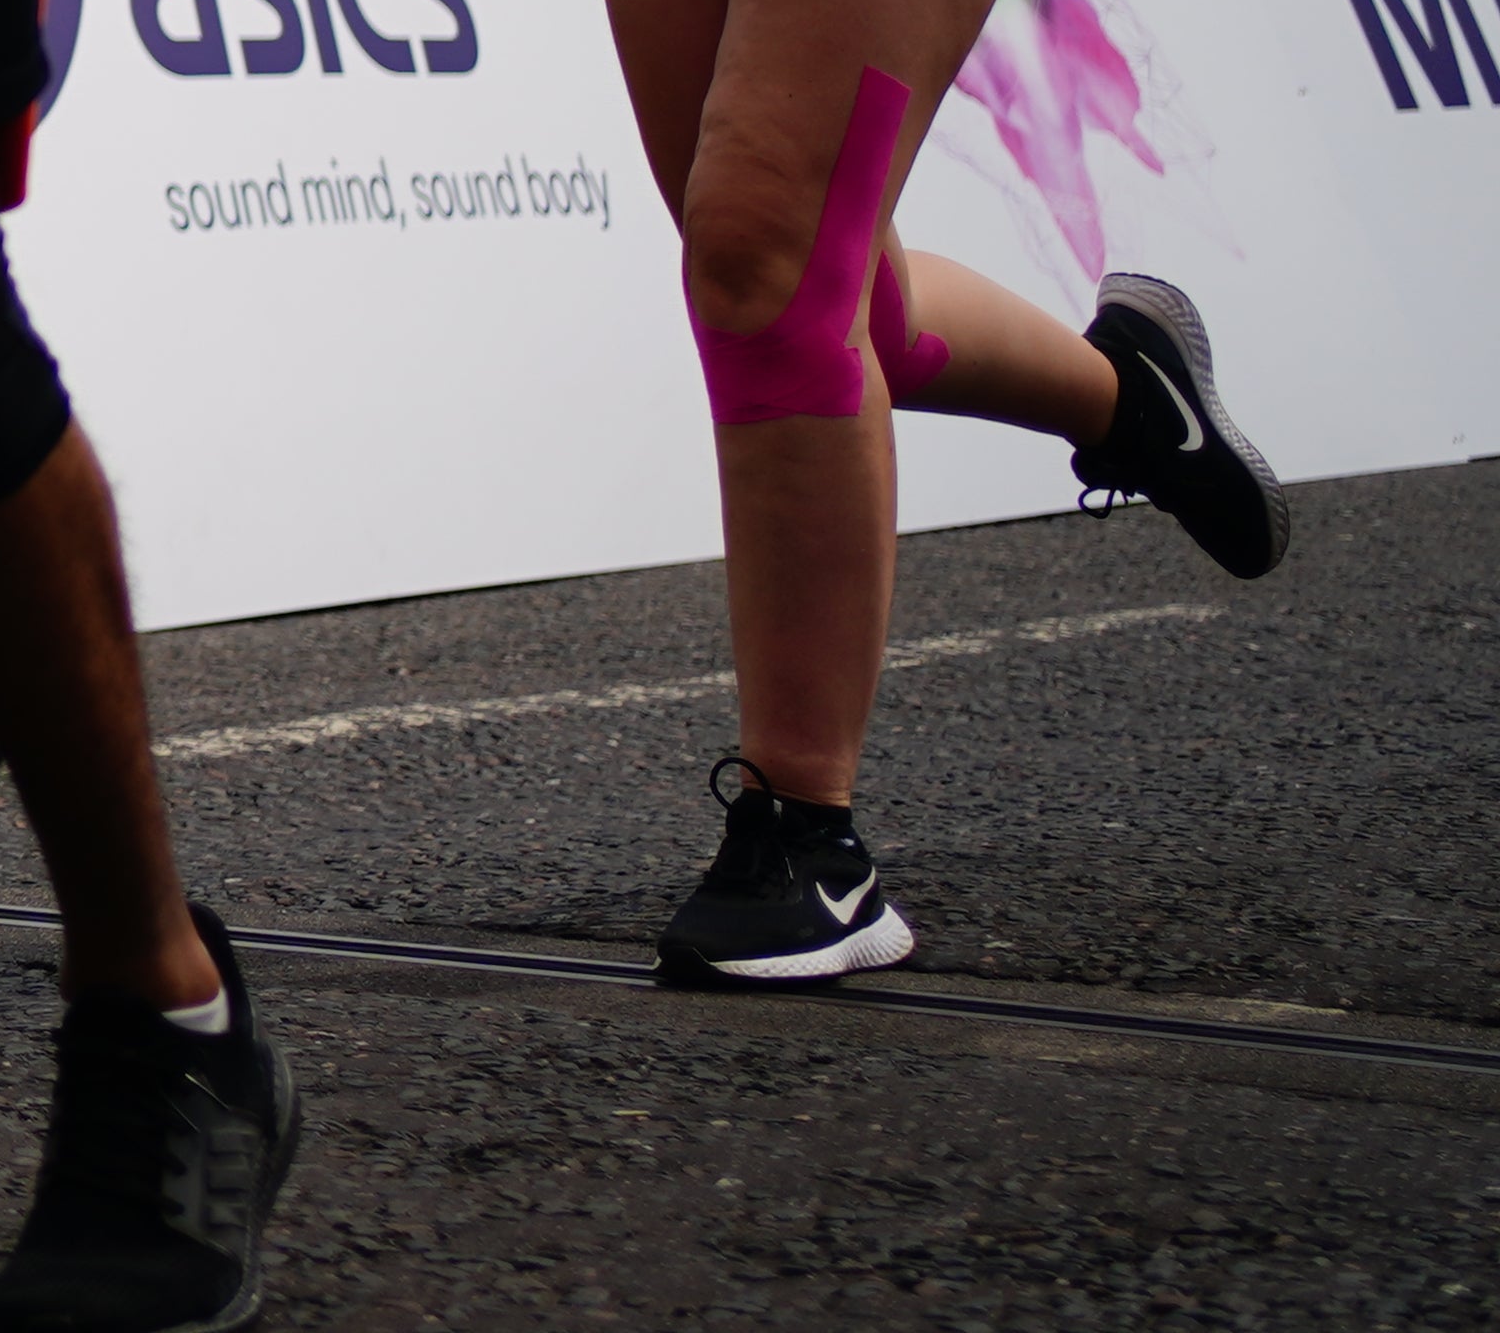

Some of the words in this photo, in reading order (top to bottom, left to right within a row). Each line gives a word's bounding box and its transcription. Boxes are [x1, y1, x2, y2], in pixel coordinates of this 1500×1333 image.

[166, 158, 294, 232] sound
[302, 157, 407, 229] mind,
[411, 154, 519, 222] sound
[521, 153, 611, 230] body
